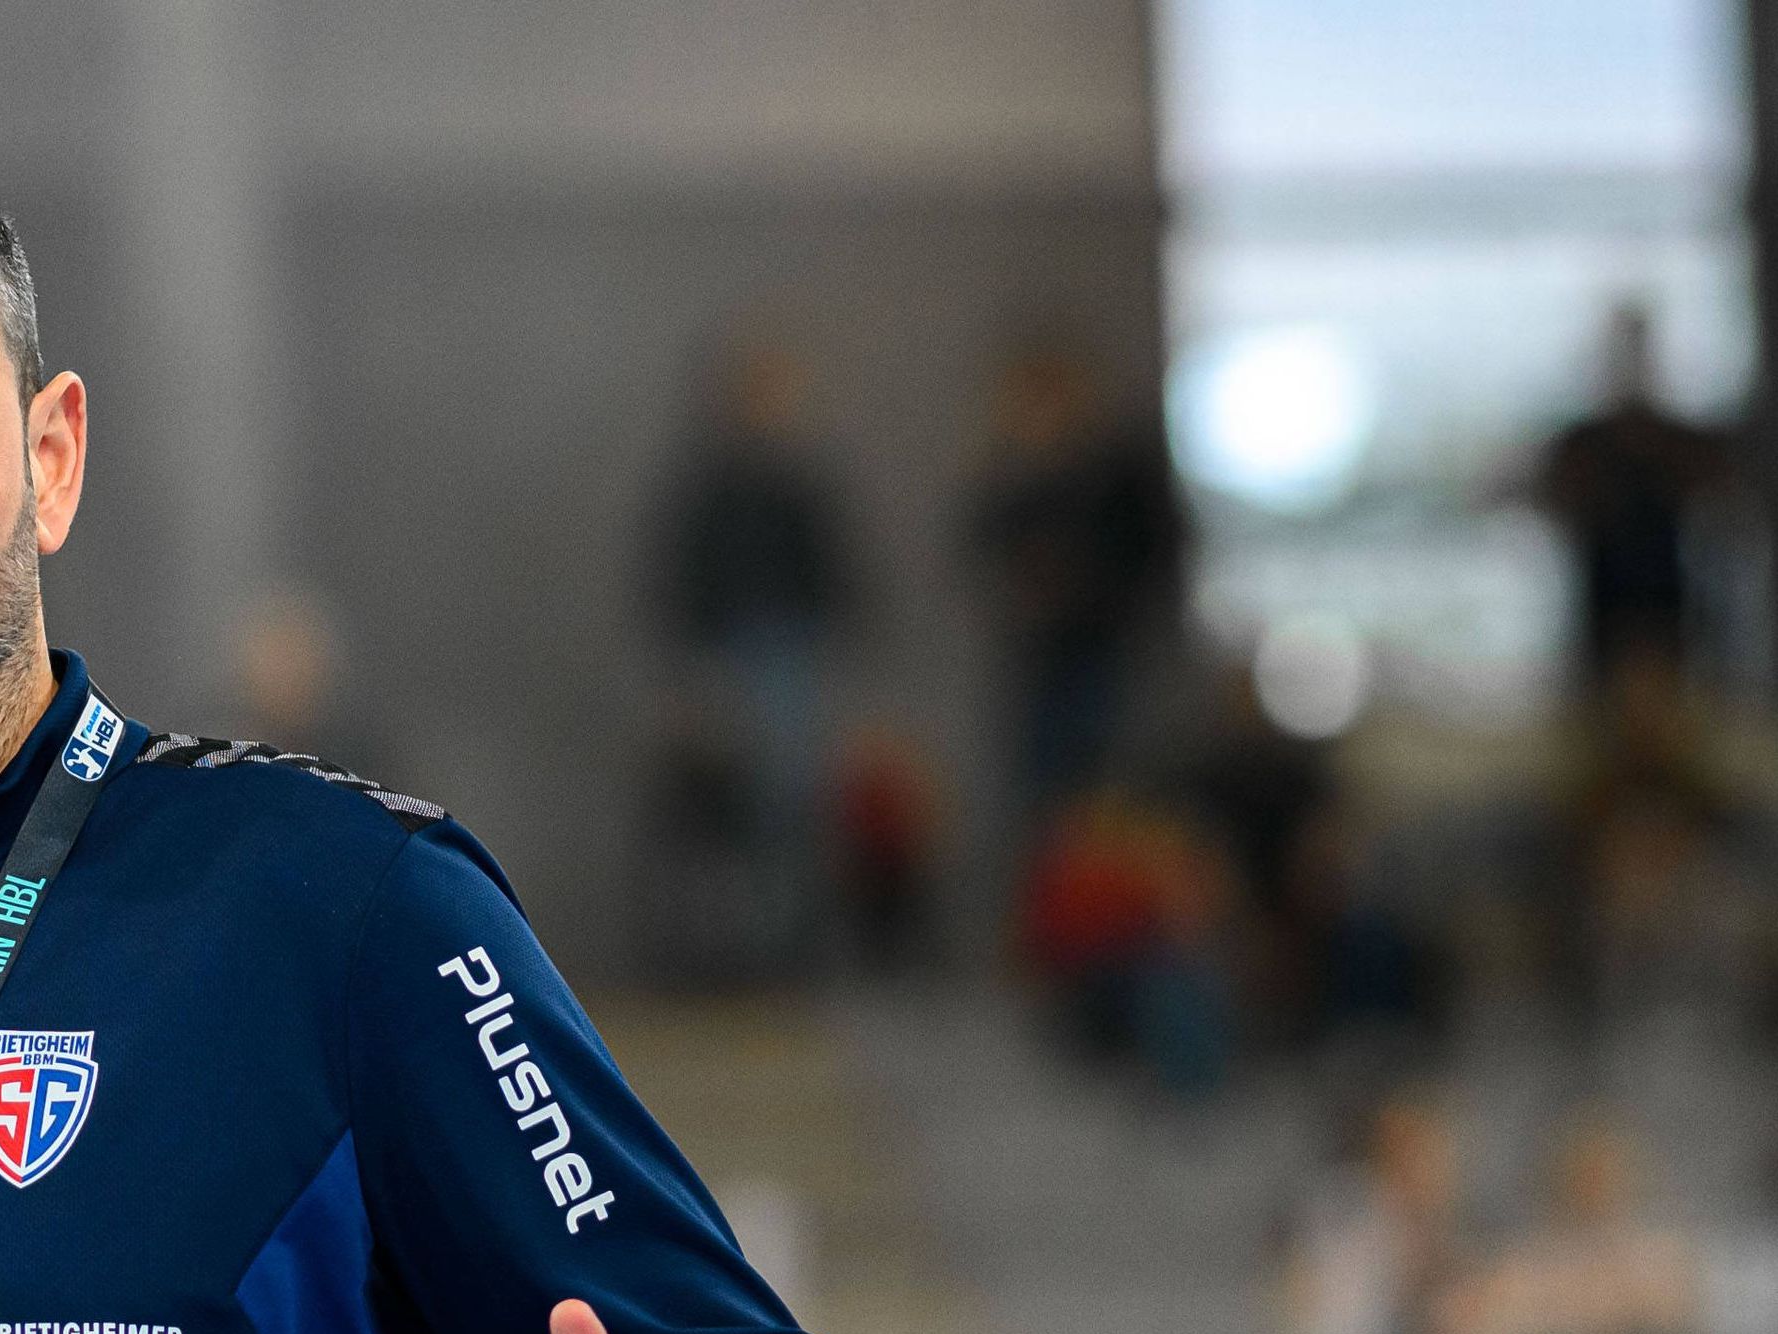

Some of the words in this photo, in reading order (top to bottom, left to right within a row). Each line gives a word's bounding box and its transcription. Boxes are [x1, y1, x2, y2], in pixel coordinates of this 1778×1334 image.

[92, 716, 118, 749] HBL
[23, 1054, 55, 1066] BBM
[437, 946, 616, 1234] Plusnet
